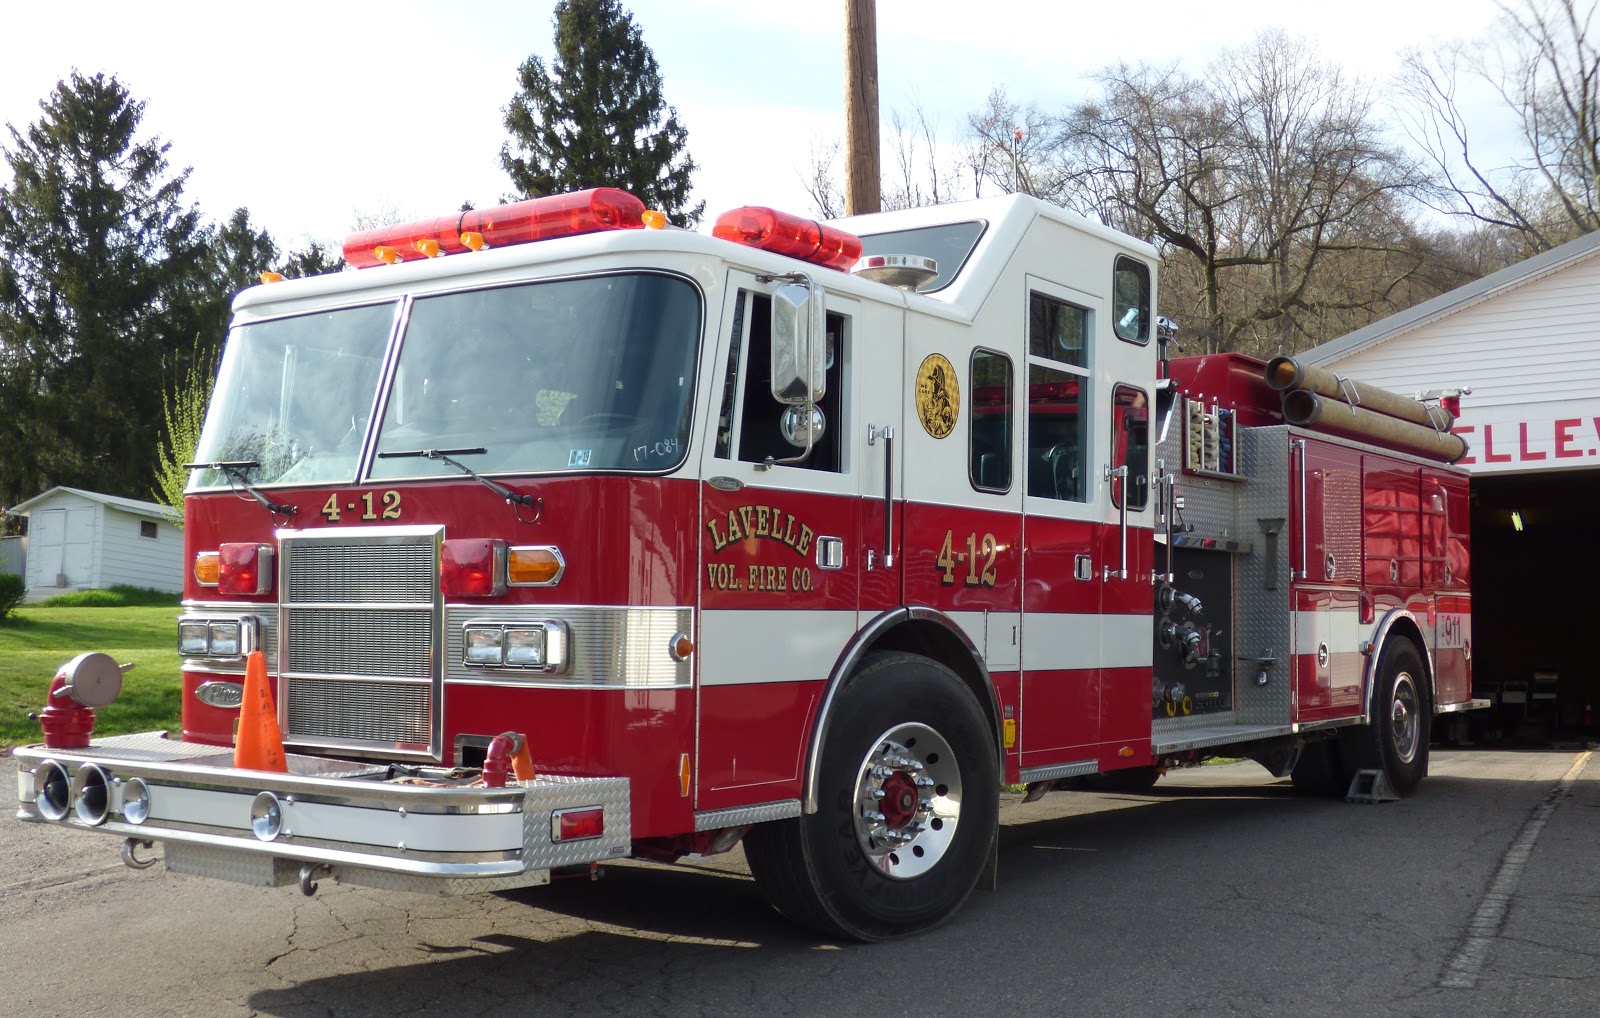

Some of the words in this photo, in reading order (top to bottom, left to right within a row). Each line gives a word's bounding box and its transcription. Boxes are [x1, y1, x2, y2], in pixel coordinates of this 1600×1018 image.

[633, 438, 679, 462] 17-084
[707, 505, 814, 557] LAVELLE
[936, 529, 997, 588] 4-12
[707, 563, 743, 590] VOL.
[748, 565, 787, 591] FIRE
[791, 567, 814, 592] CO.
[1445, 614, 1461, 647] 911
